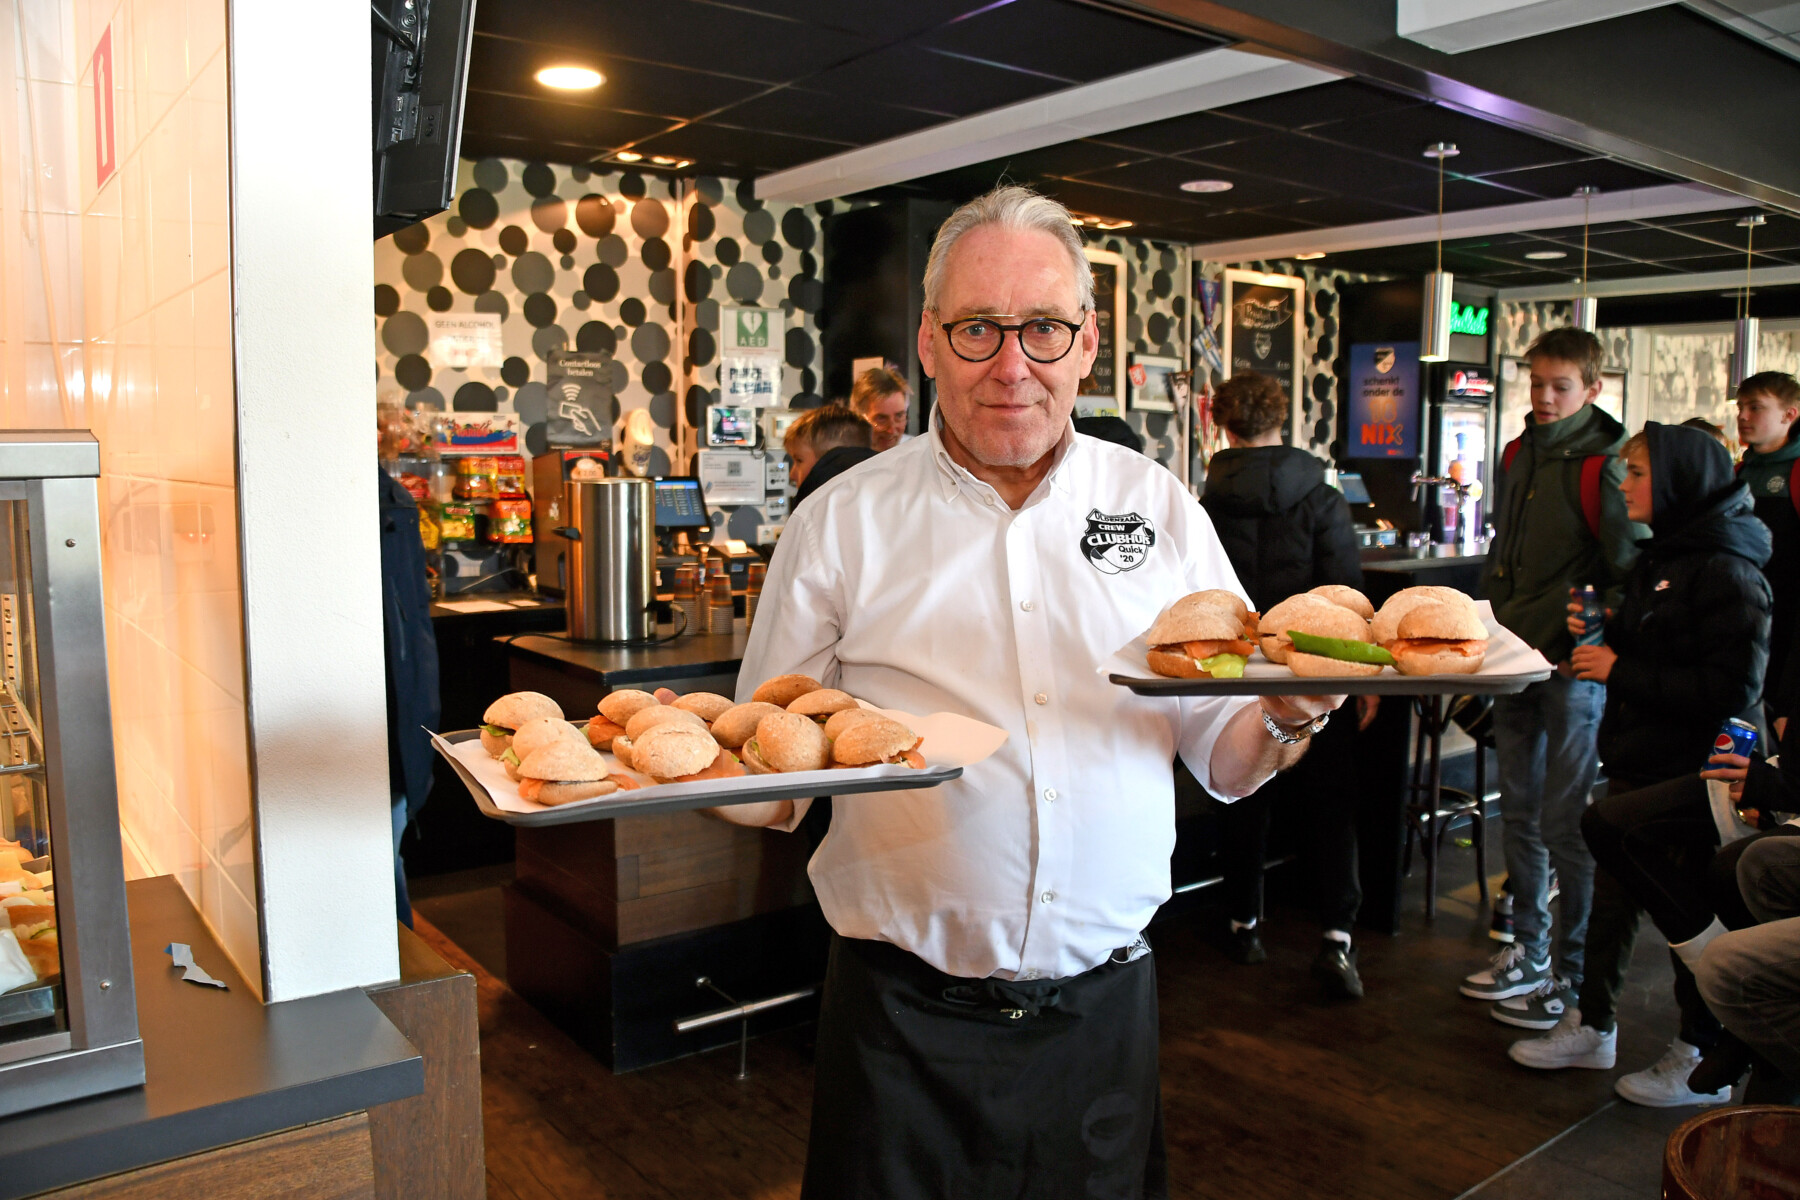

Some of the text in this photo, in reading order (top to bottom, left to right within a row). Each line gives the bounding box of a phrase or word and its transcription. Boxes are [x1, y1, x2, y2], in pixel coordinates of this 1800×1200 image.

[740, 337, 766, 346] AED
[559, 360, 601, 368] Contactloos
[567, 368, 594, 376] betalen
[1364, 376, 1400, 386] schenkt
[1364, 387, 1404, 397] onder de
[1361, 424, 1404, 445] NIX
[1095, 511, 1138, 522] OLDENZAAL
[1118, 545, 1143, 555] Quick
